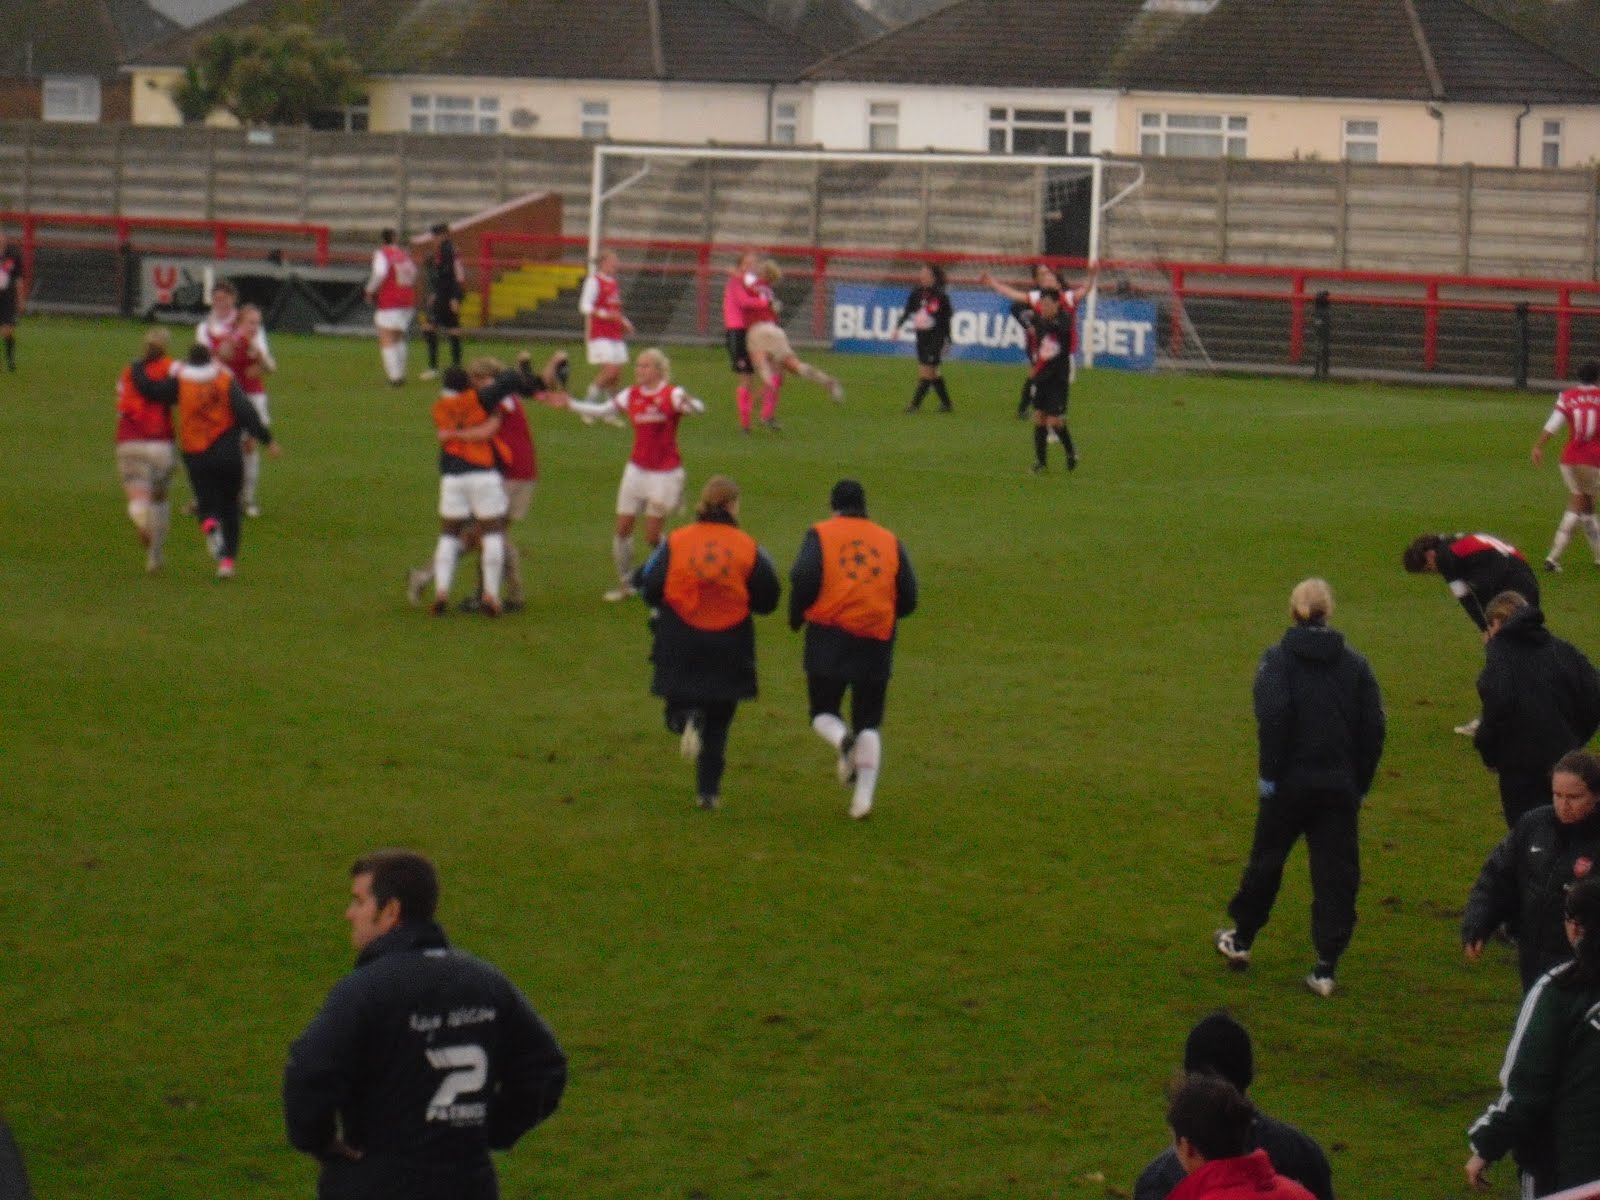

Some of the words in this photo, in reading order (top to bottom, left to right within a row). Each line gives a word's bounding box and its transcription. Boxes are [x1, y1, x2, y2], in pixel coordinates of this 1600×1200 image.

[951, 311, 1027, 349] QUA
[1082, 318, 1153, 356] BET
[1573, 407, 1598, 441] 11
